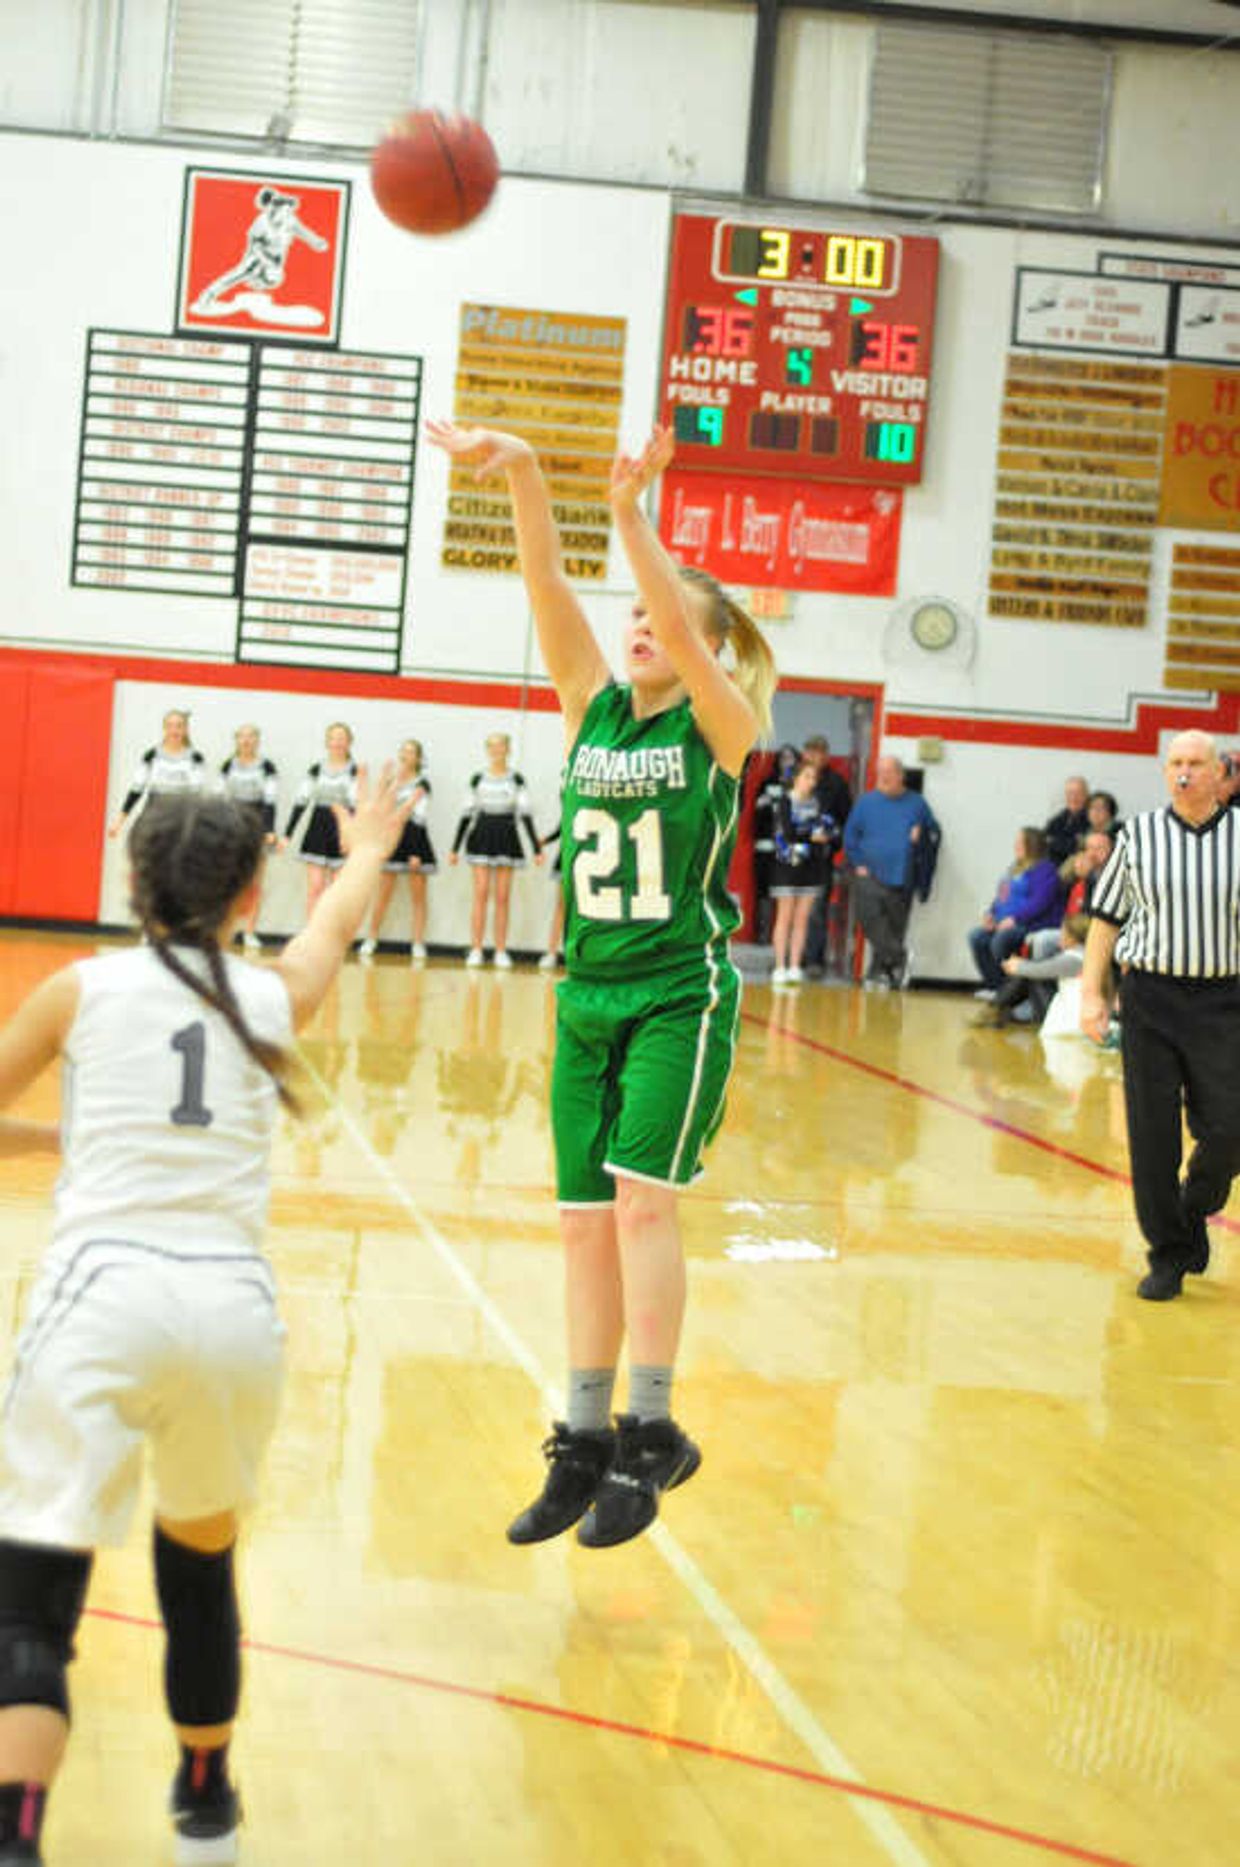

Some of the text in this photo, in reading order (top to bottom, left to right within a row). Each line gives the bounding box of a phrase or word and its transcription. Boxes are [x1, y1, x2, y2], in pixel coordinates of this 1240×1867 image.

[464, 305, 620, 348] Platinum
[694, 306, 753, 355] 36
[769, 325, 832, 348] PERIOD
[859, 322, 919, 373] 36
[669, 355, 758, 387] HOME
[830, 369, 928, 399] VISITOR
[667, 383, 731, 405] FOULS
[760, 390, 832, 414] PLAYER
[859, 400, 922, 423] FOULS
[697, 406, 723, 446] 9
[877, 421, 916, 463] 10
[572, 808, 672, 921] 21
[170, 1020, 214, 1128] 1
